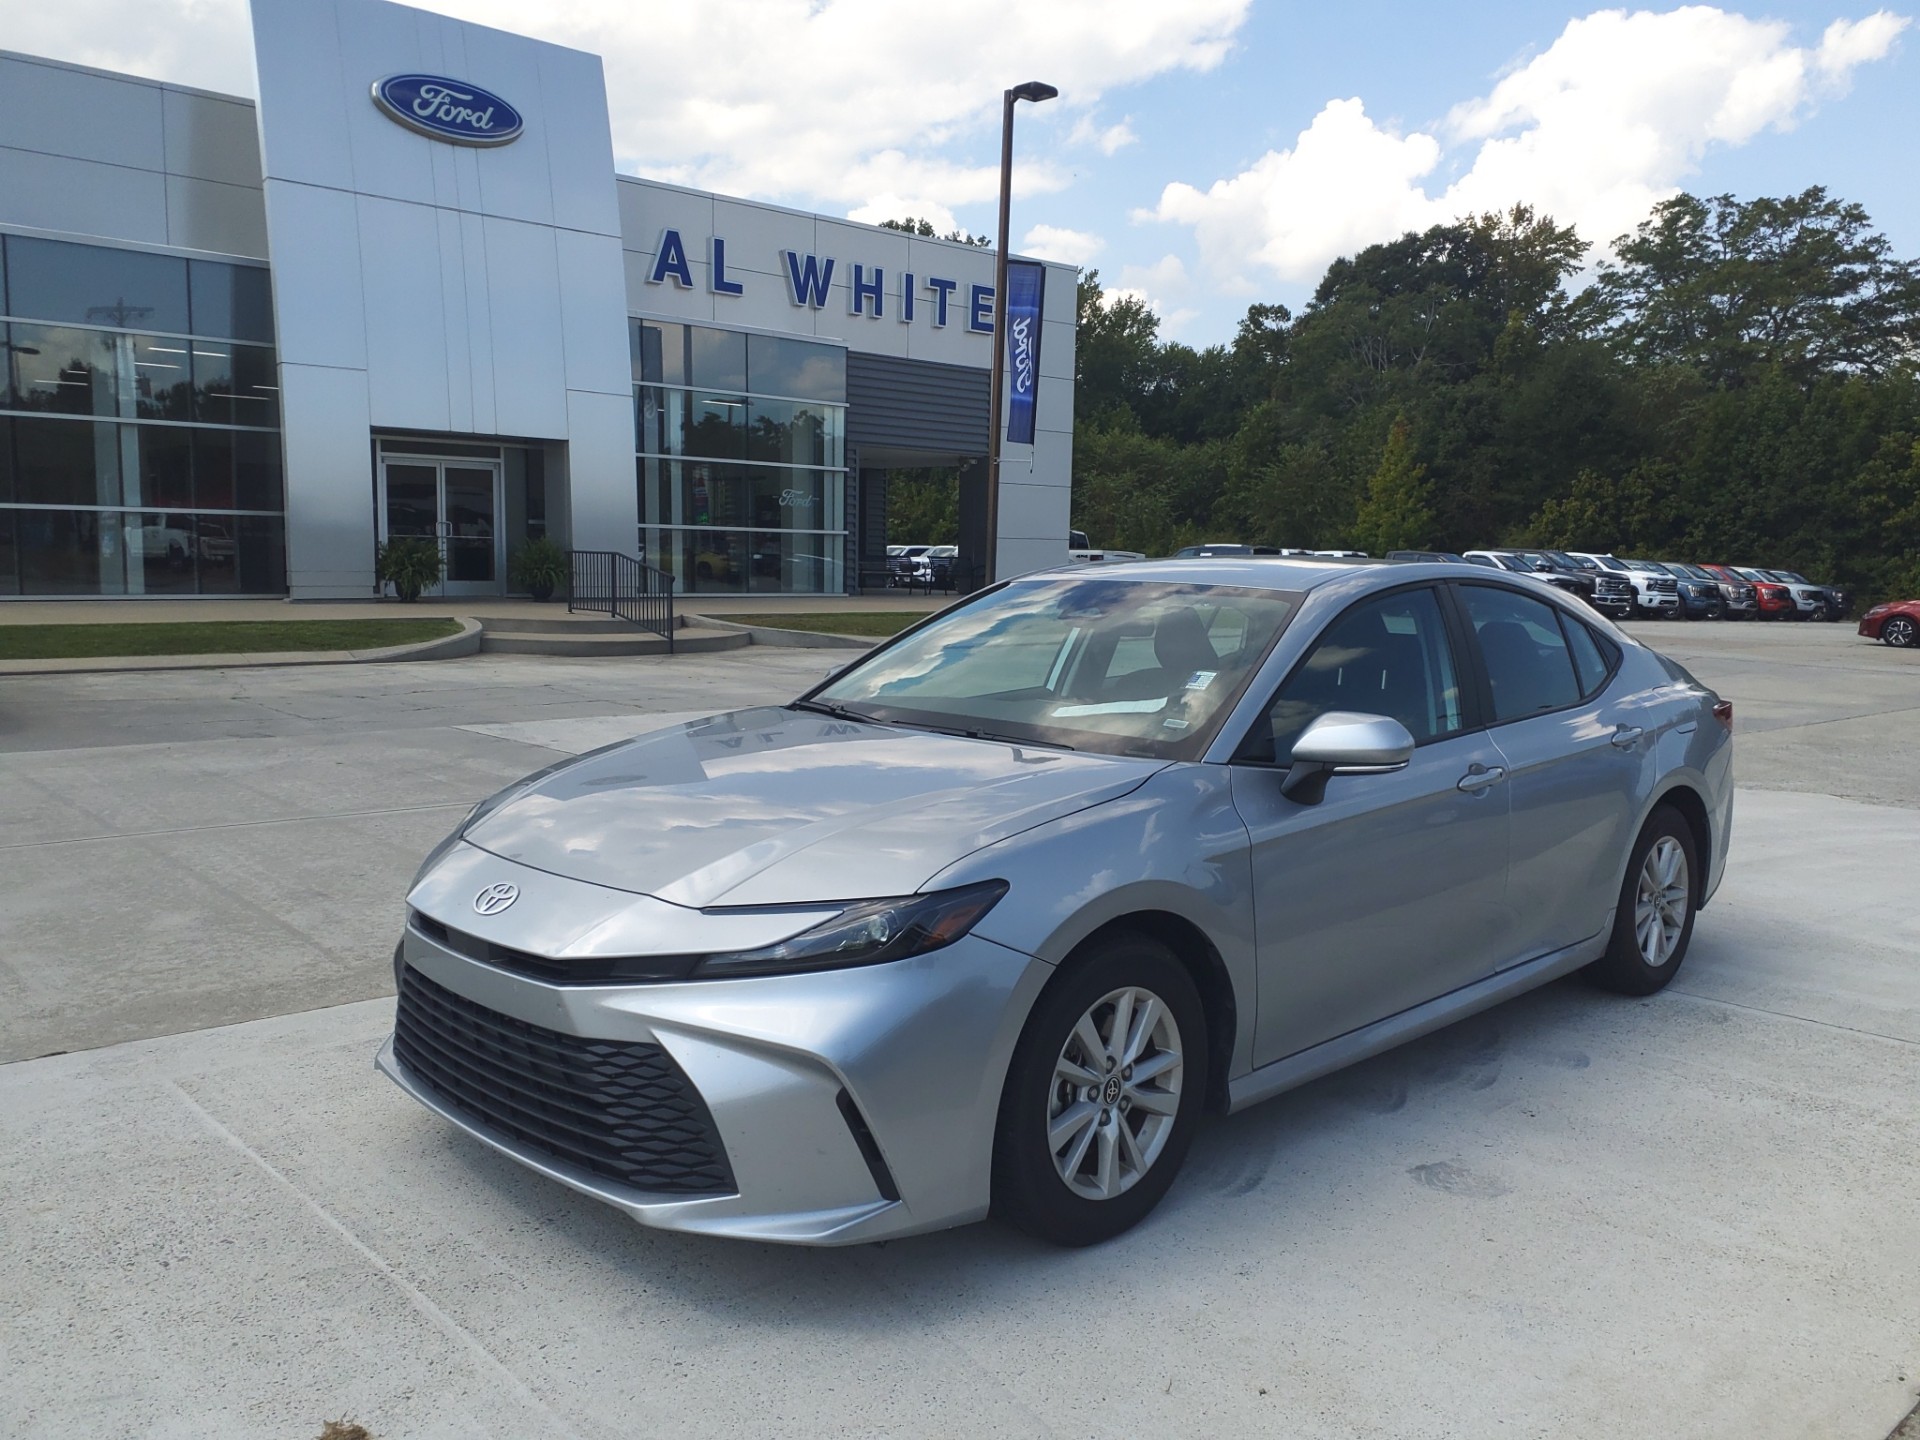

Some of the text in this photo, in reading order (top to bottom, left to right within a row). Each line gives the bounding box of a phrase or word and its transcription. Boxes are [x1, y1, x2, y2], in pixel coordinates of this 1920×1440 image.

[413, 84, 494, 130] Ford
[647, 227, 996, 335] AL WHITE
[778, 488, 812, 507] Ford
